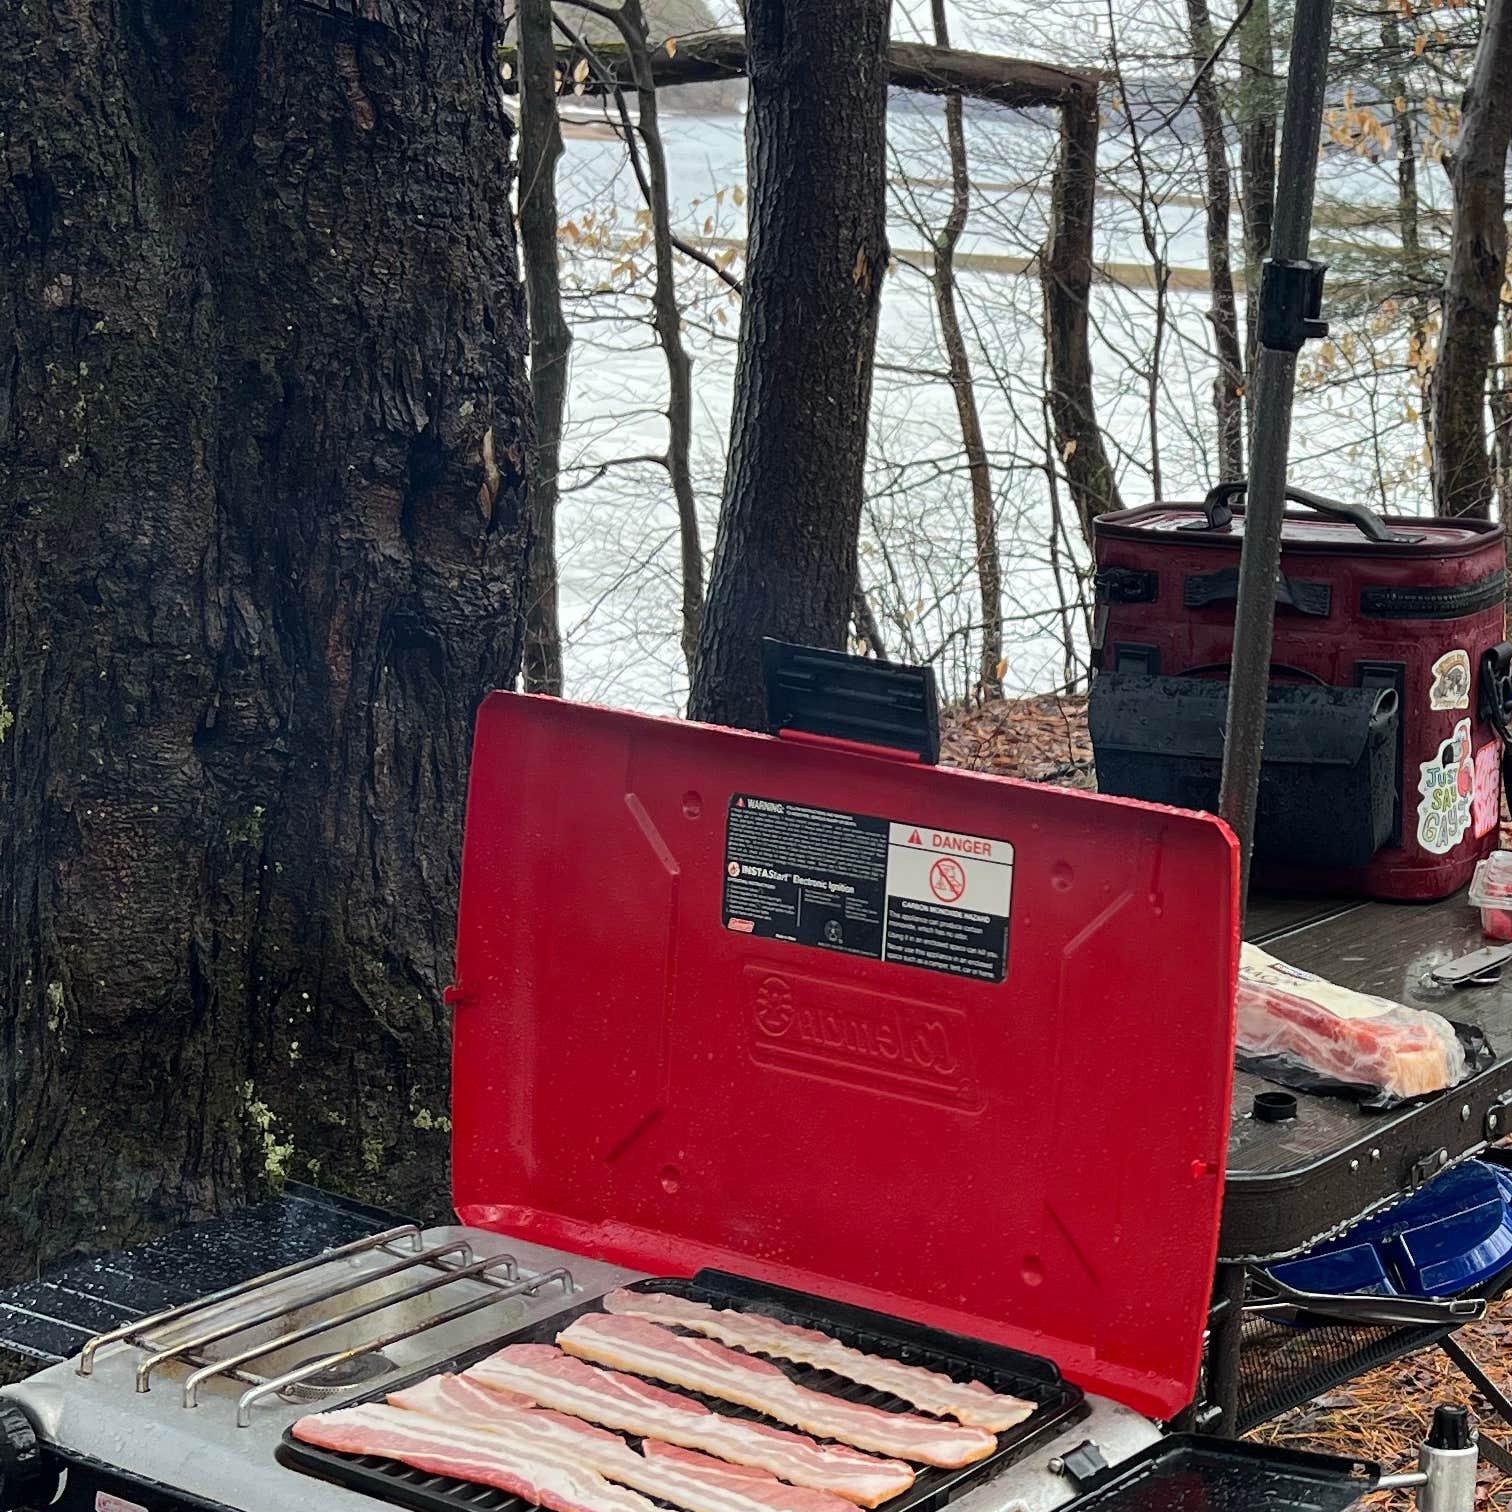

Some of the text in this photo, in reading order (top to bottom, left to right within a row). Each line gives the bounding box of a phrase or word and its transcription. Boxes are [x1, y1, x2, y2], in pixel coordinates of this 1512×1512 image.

[1427, 768, 1457, 788] JUST
[748, 799, 784, 814] WARNING:
[1432, 788, 1457, 812] SAY
[1422, 807, 1457, 847] GAY
[932, 834, 992, 856] DANGER
[792, 874, 827, 889] Electronic
[828, 881, 855, 893] Ignition
